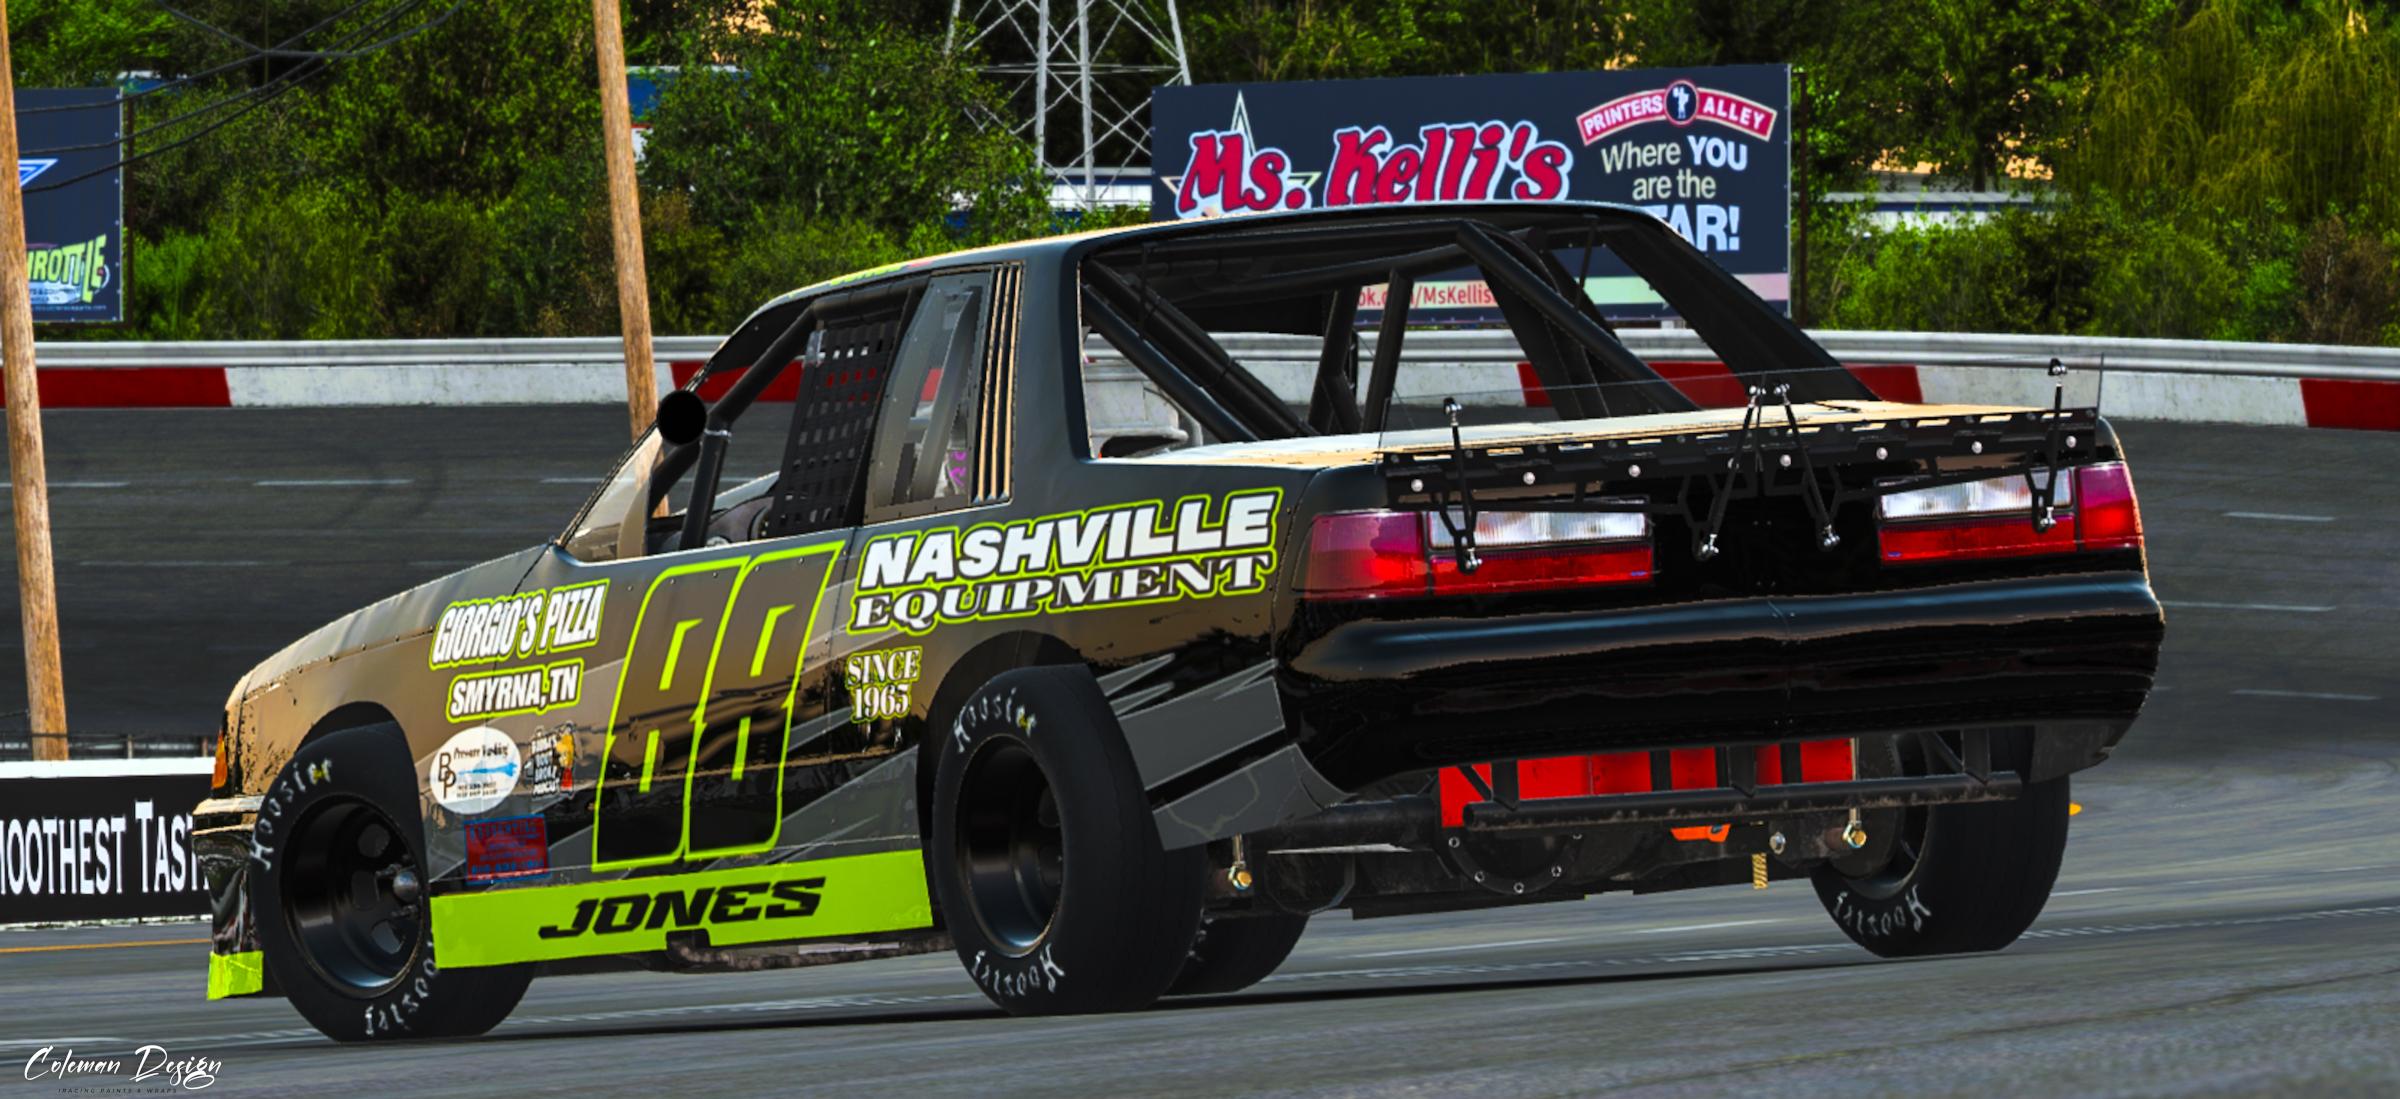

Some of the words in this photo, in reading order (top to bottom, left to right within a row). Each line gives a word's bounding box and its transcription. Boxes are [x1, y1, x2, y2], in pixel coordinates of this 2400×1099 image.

[1583, 95, 1664, 137] PRINTERS
[1703, 96, 1765, 130] ALLEY
[1178, 130, 1310, 214] Ms.
[1325, 121, 1572, 207] Kelli's
[1601, 140, 1681, 174] Where
[1687, 135, 1748, 171] YOU
[1632, 175, 1672, 201] are
[1676, 168, 1717, 199] the
[859, 493, 1277, 591] NASHVILLE
[431, 595, 543, 664] GIORGIO'S
[539, 584, 606, 649] PIZZA
[852, 554, 1272, 632] EQUIPMENT
[847, 649, 919, 686] SINCE
[852, 684, 910, 721] 1965
[591, 540, 846, 873] 88
[0, 816, 126, 895] OOTHEST
[135, 799, 210, 894] TAST
[538, 877, 826, 940] JONES
